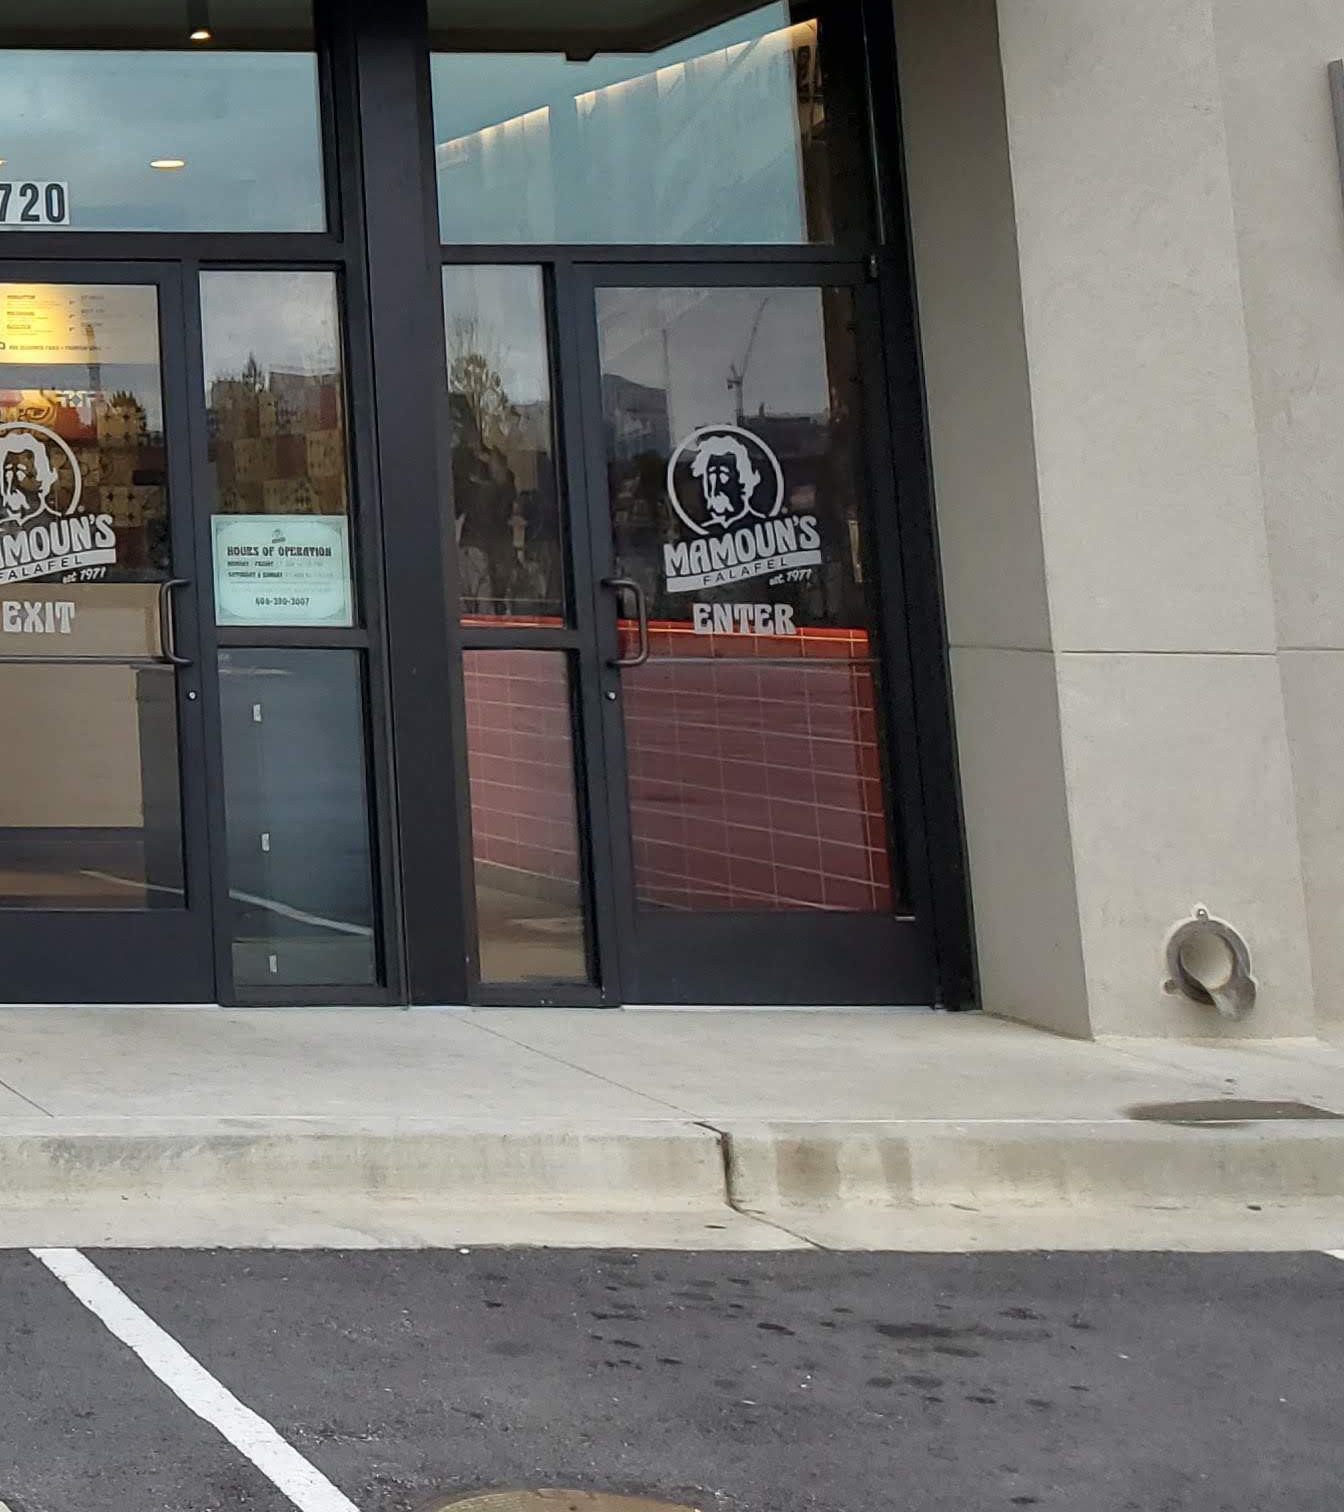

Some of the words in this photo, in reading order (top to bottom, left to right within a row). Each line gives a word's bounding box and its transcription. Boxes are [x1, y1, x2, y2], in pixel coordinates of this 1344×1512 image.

[226, 546, 259, 557] HOURS
[262, 546, 275, 557] OF
[278, 546, 332, 557] OPERATION
[663, 515, 821, 577] MAMOUN'S
[79, 567, 107, 582] 1971
[702, 557, 788, 585] FALAFEL
[786, 568, 812, 582] 1971
[1, 600, 76, 634] EXIT
[692, 603, 797, 635] ENTER
